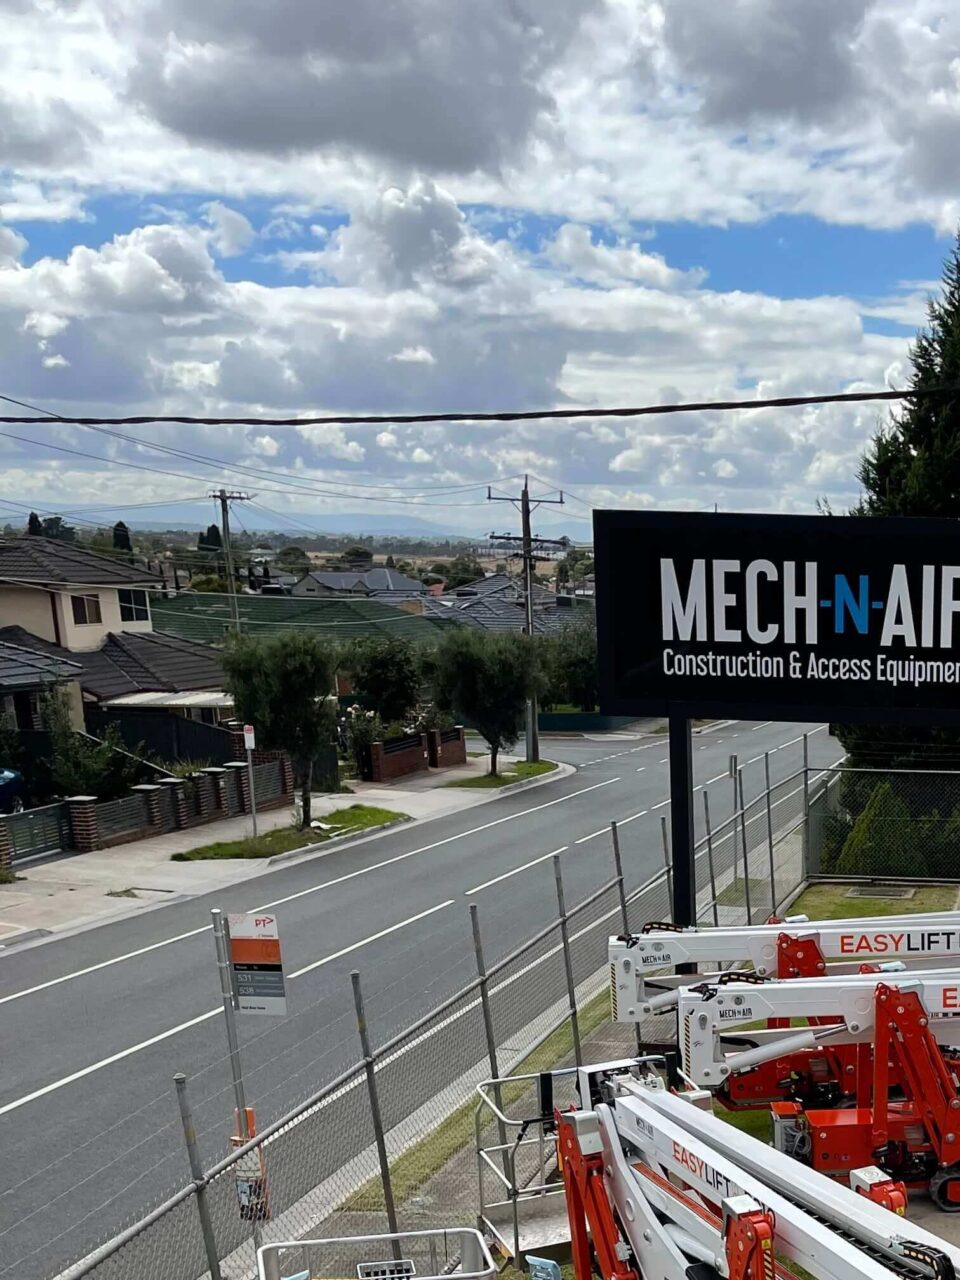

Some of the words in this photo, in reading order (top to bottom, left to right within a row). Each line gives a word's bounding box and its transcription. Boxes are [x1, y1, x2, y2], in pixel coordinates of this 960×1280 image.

[663, 648, 784, 678] Construction
[789, 651, 802, 679] &
[807, 652, 871, 680] Access
[840, 932, 956, 953] EASYLIFT
